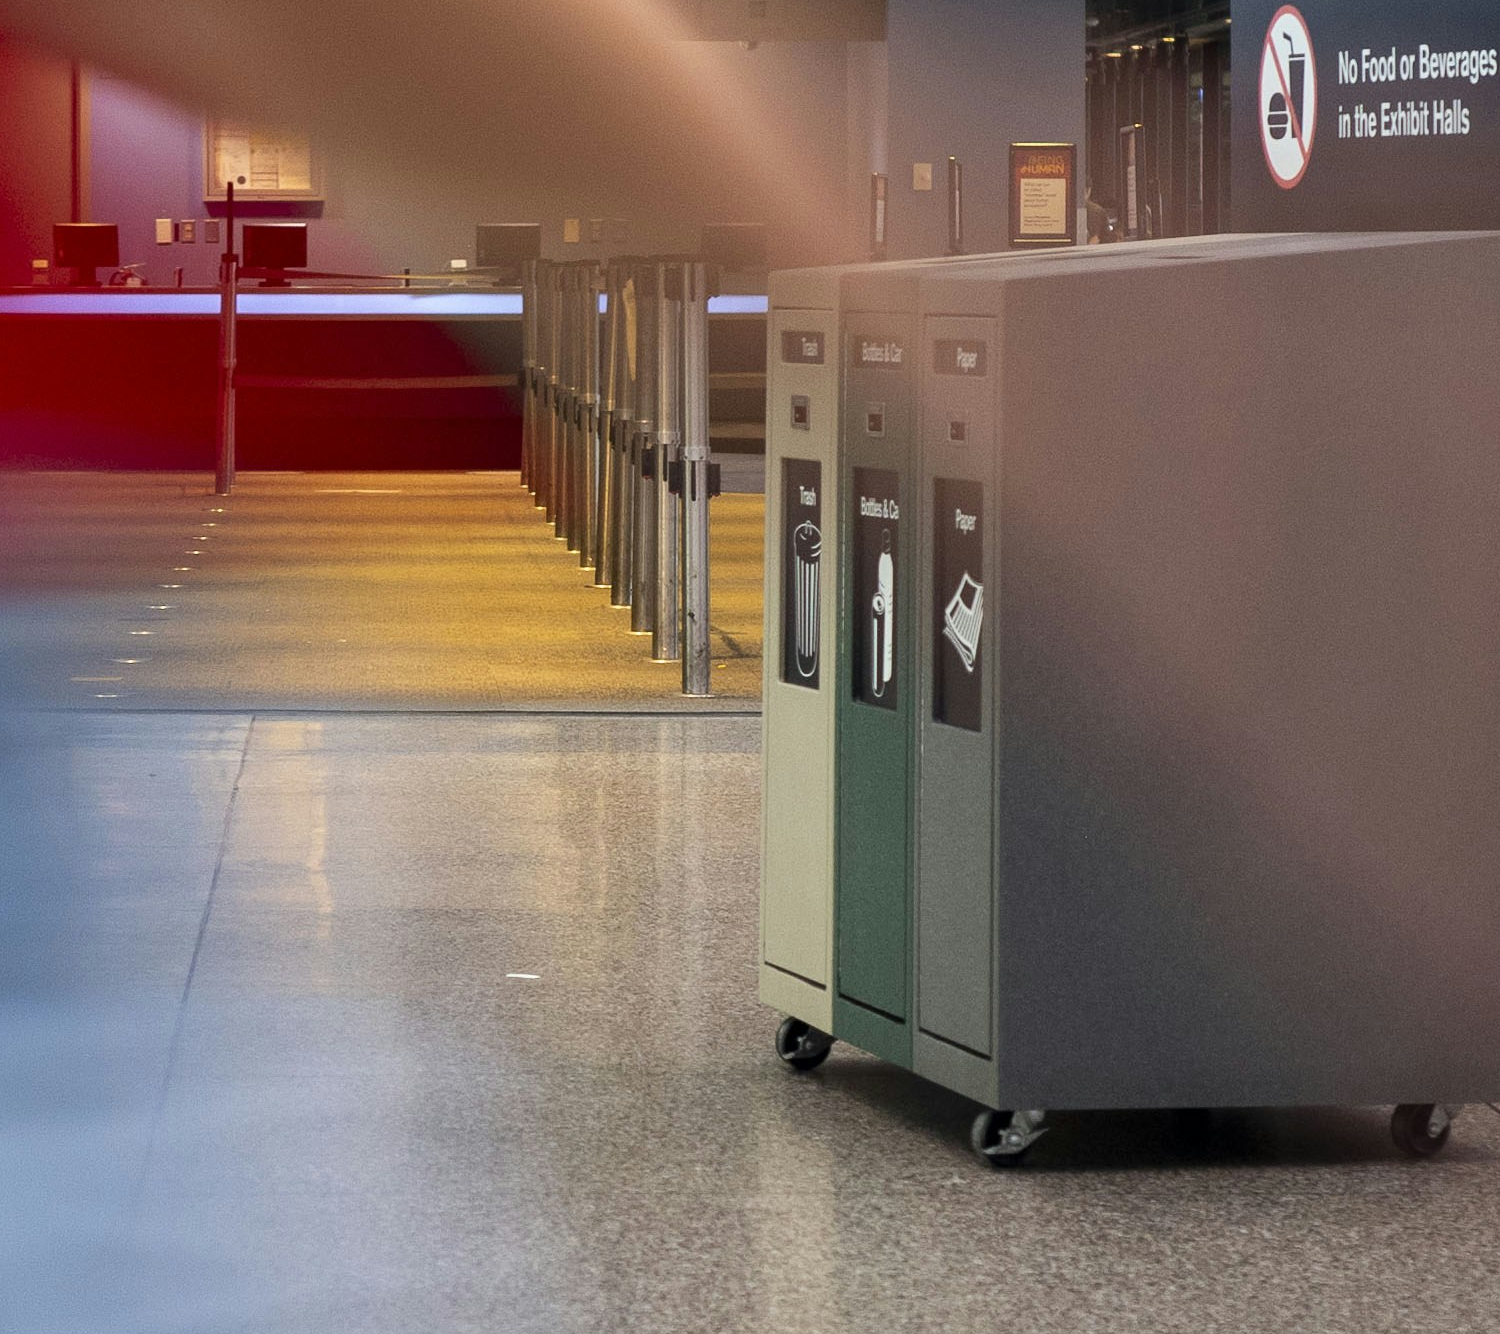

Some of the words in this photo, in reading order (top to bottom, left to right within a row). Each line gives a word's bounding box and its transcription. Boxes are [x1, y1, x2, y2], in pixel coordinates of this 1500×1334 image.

[1338, 51, 1358, 85] No
[1361, 46, 1397, 83] Food
[1399, 55, 1416, 81] or
[1419, 44, 1498, 84] Beverages
[1338, 105, 1352, 139] in
[1354, 104, 1377, 138] the
[1380, 101, 1429, 137] Exhibit
[1432, 99, 1471, 136] Halls
[956, 347, 978, 373] Paper
[799, 485, 817, 507] Trash
[860, 496, 883, 518] Bottles
[883, 498, 890, 519] &
[889, 499, 900, 520] Ca
[955, 508, 978, 534] Paper
